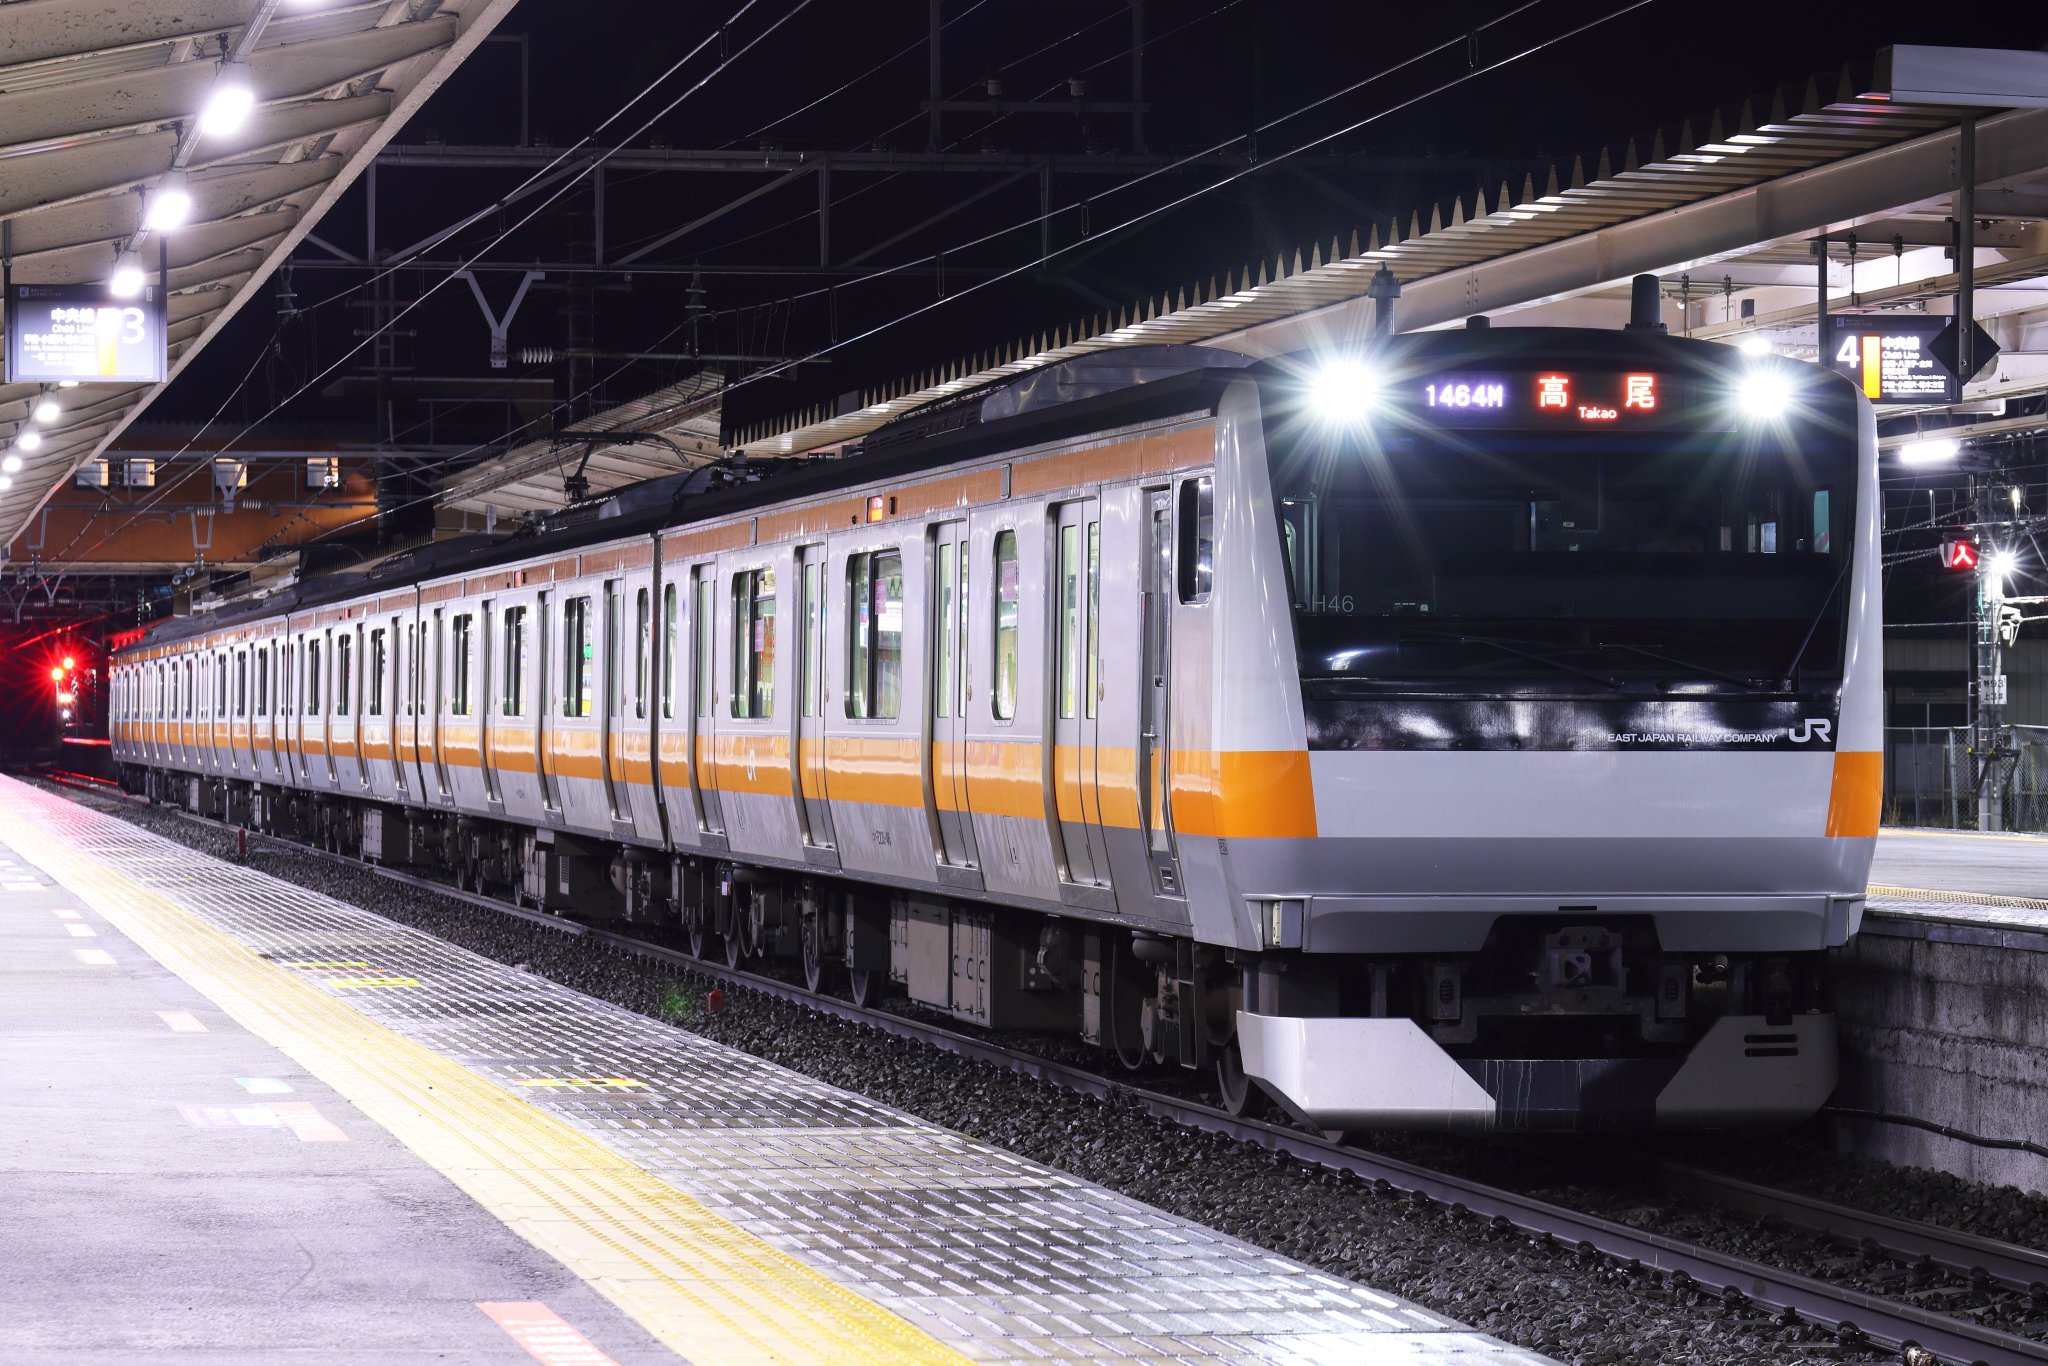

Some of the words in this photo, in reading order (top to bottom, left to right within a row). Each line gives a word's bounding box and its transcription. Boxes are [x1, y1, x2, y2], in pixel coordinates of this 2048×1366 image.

[121, 307, 146, 345] 3
[1836, 336, 1860, 368] 4
[1426, 384, 1504, 407] 1464M
[1578, 406, 1617, 419] Takao
[1312, 595, 1354, 612] H46
[1607, 733, 1637, 743] EAST
[1637, 733, 1675, 743] JAPAN
[1677, 733, 1723, 743] RAILWAY
[1723, 733, 1778, 743] COMPANY
[1788, 718, 1832, 743] JR
